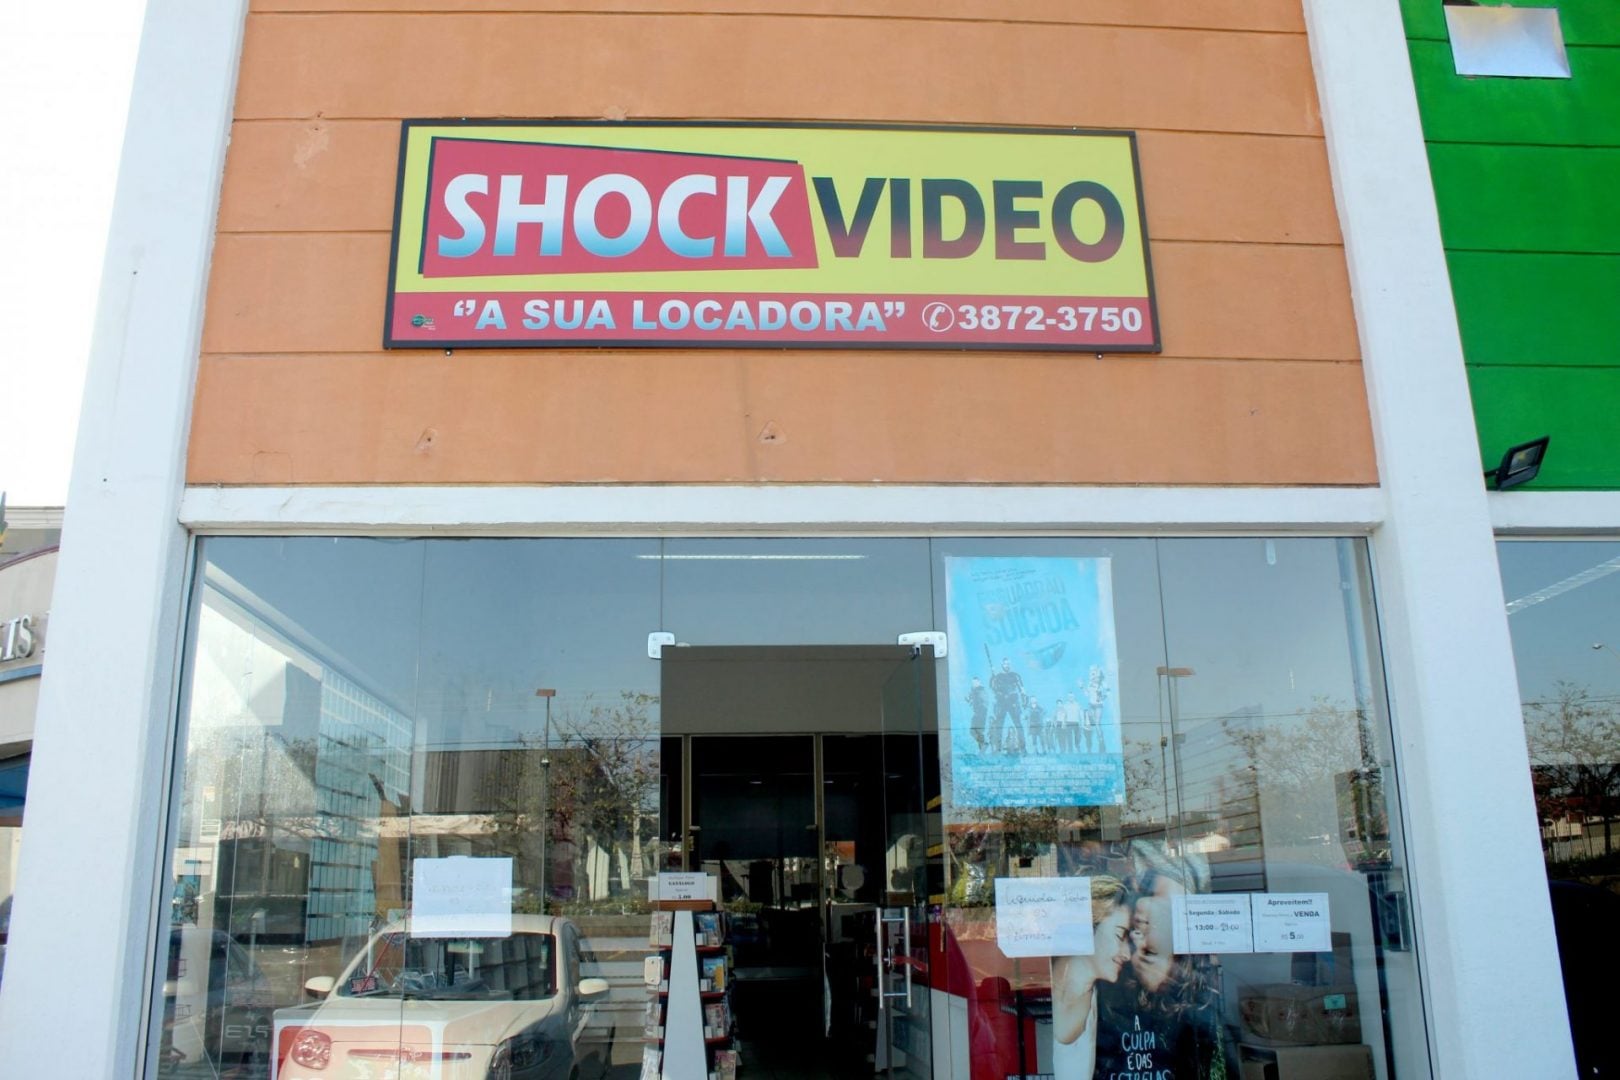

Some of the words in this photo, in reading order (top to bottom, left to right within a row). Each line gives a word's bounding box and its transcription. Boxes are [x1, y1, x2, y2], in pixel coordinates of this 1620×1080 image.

[438, 173, 792, 258] SHOCK
[812, 177, 1125, 263] VIDEO
[523, 300, 616, 330] SUA
[959, 305, 1142, 332] 3872-3750
[983, 598, 1080, 645] SUICIDA
[1134, 1014, 1140, 1031] A
[1121, 1031, 1155, 1051] CULPA
